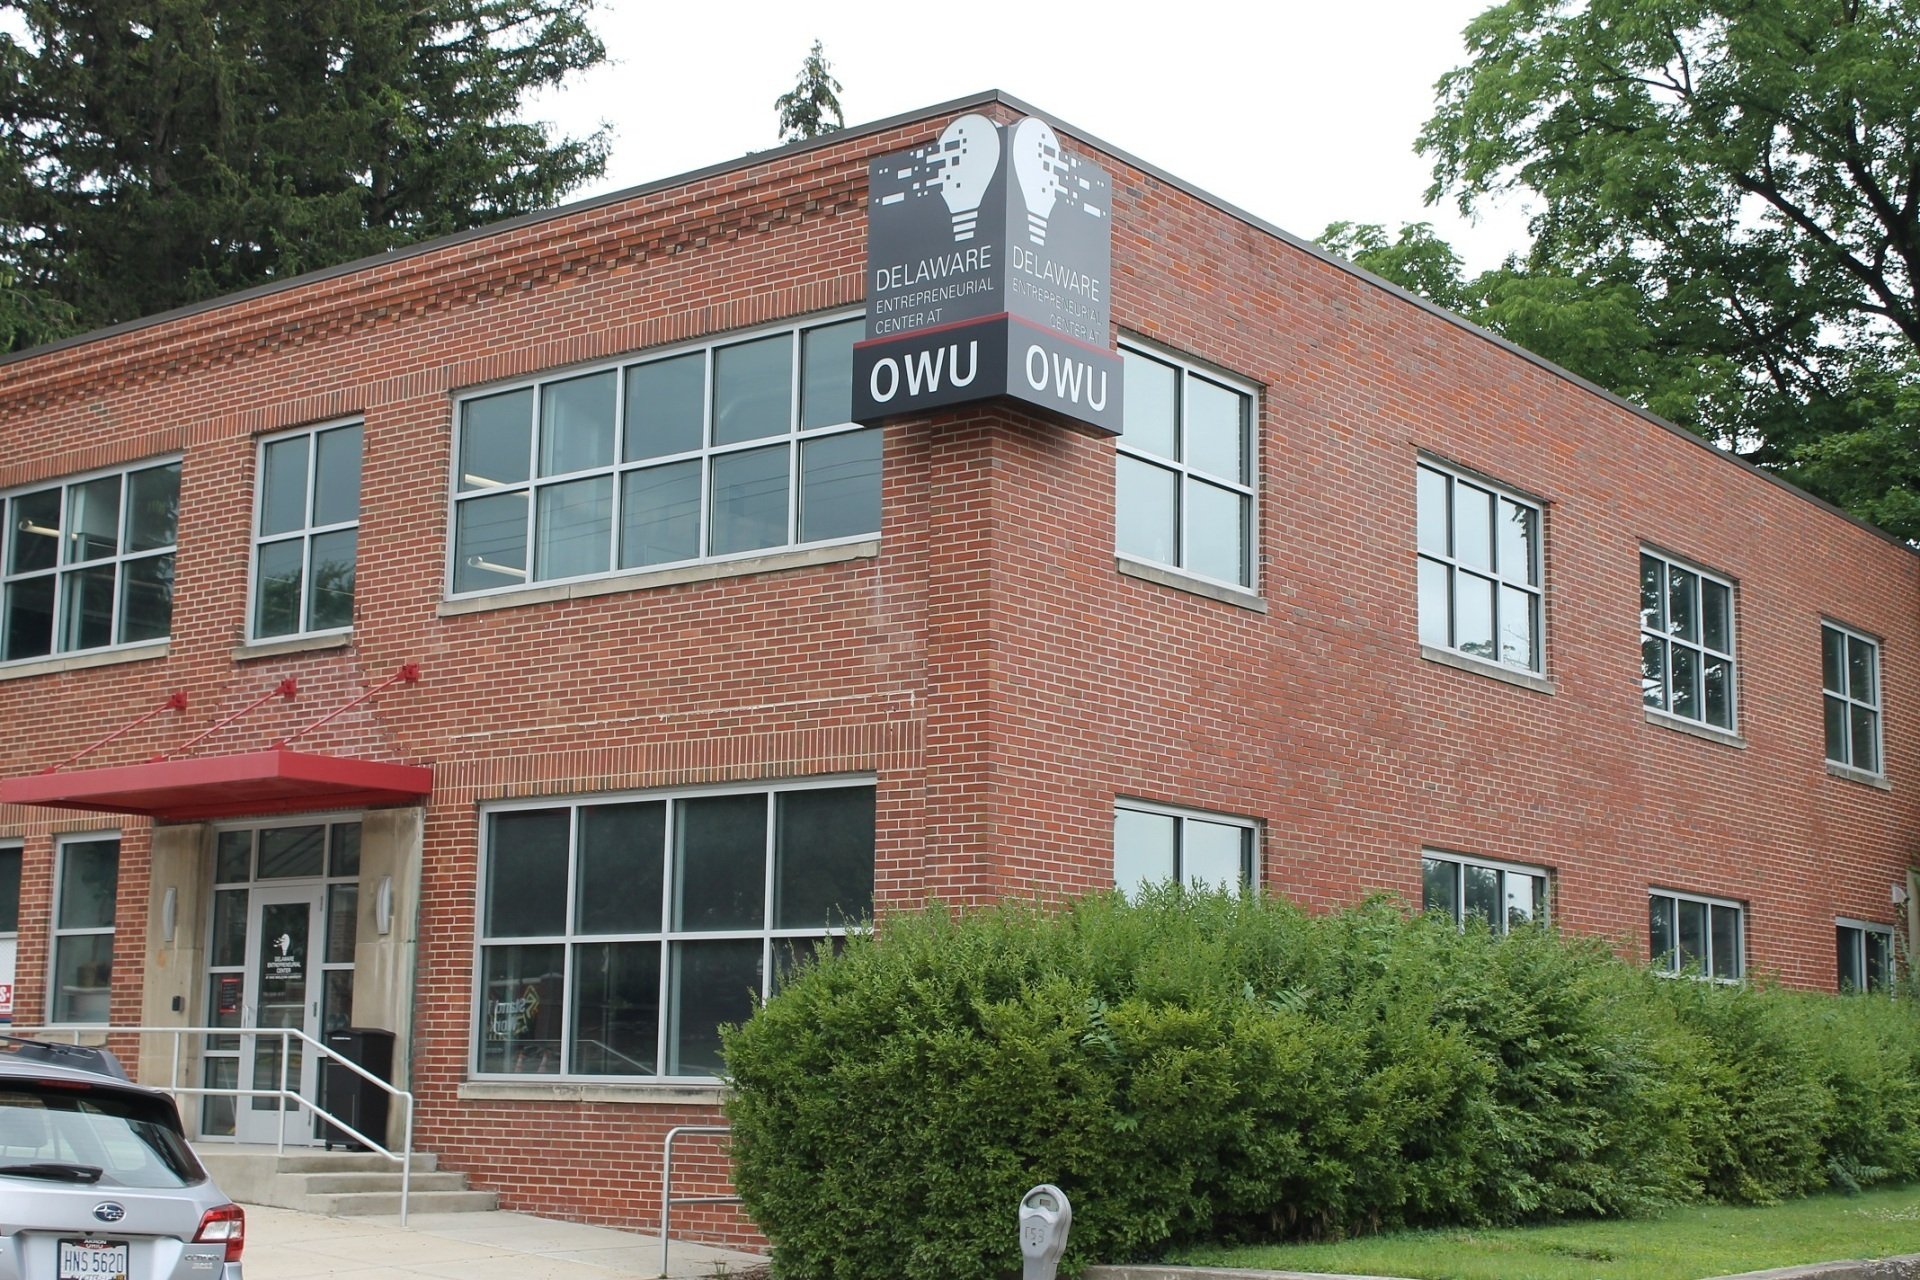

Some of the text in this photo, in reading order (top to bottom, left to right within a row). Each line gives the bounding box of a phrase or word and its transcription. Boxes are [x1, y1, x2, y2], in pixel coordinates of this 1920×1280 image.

[876, 245, 991, 291] DELAWARE
[1013, 245, 1099, 302] DELAWARE
[876, 277, 994, 314] ENTREPRENEURIAL
[1012, 277, 1101, 326] ENTREPRENEURIAL
[875, 308, 943, 334] CENTER AT
[1050, 313, 1101, 344] CENTER AT
[870, 340, 978, 403] OWU
[1026, 344, 1107, 412] OWU
[65, 1250, 124, 1273] HNS 5620
